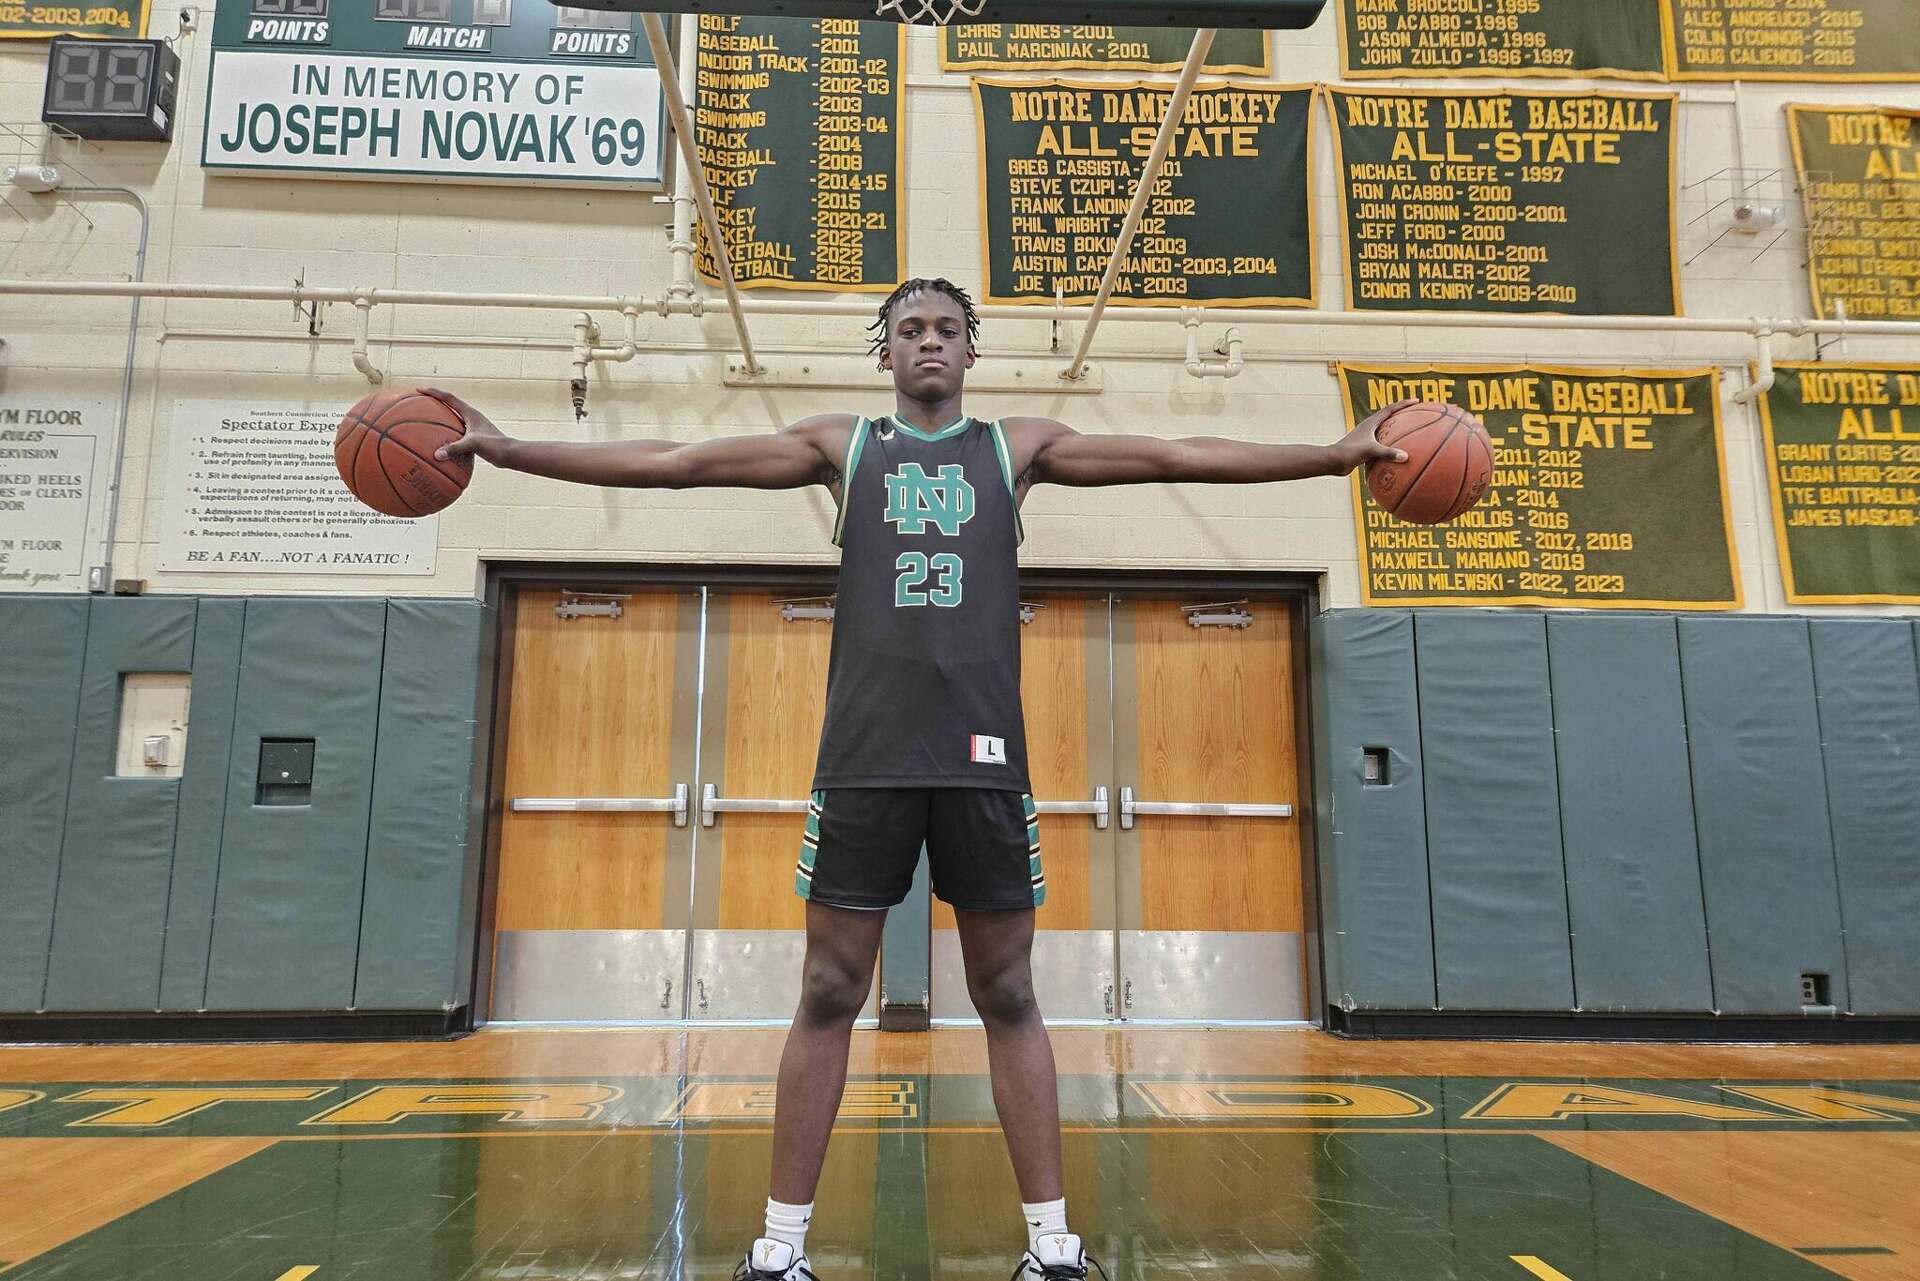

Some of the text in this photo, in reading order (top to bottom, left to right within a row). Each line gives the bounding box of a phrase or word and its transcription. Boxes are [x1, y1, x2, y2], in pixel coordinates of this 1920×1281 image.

[1356, 0, 1398, 13] MARK
[248, 20, 329, 41] POINTS
[700, 14, 741, 32] GOLF
[956, 24, 1001, 39] CHRIS
[1356, 15, 1388, 31] BOB
[407, 26, 486, 49] MATCH
[552, 32, 631, 53] POINTS
[699, 32, 779, 51] BASEBALL
[1359, 31, 1411, 48] JASON
[958, 42, 999, 58] PAUL
[1361, 48, 1402, 65] JOHN
[699, 52, 752, 71] INDOOR
[757, 54, 808, 73] TRACK
[292, 64, 584, 105] IN MEMORY OF
[698, 71, 769, 89] SWIMMING
[698, 89, 750, 110] TRACK
[1010, 91, 1092, 122] NOTRE
[1184, 94, 1281, 125] HOCKEY
[697, 108, 766, 128] SWIMMING
[1346, 96, 1660, 132] NOTRE DAME BASEBALL
[221, 103, 401, 158] JOSEPH
[697, 126, 748, 149] TRACK
[1827, 114, 1911, 147] NOTRE
[697, 145, 776, 167] BASEBALL
[1009, 159, 1048, 176] GREG
[1350, 161, 1565, 183] MICHAEL O'KEEFE 1997
[1010, 178, 1062, 195] STEVE
[1352, 183, 1384, 200] RON
[1011, 198, 1064, 214] FRANK
[1355, 204, 1396, 220] JOHN
[1012, 217, 1047, 233] PHIL
[1357, 223, 1396, 240] JEFF
[1012, 236, 1066, 253] TRAVIS
[1358, 243, 1399, 260] JOSH
[1012, 256, 1067, 273] AUSTIN
[1359, 263, 1410, 280] BRYAN
[1013, 276, 1044, 292] JOE
[1360, 282, 1411, 299] CONOR
[1368, 378, 1694, 415] NOTRE DAME BASEBALL
[1800, 372, 1889, 405] NOTRE
[26, 409, 82, 426] FLOOR
[221, 418, 294, 432] Spectator
[211, 436, 292, 446] Respect decisions
[1777, 444, 1831, 461] GRANT
[38, 474, 82, 486] HEELS
[1781, 465, 1835, 482] LOGAN
[36, 488, 82, 499] CLEATS
[1783, 487, 1816, 504] TYE
[1788, 508, 1842, 526] JAMES
[202, 529, 240, 538] Respect
[1370, 531, 1440, 549] MICHAEL
[1446, 530, 1522, 549] SANSONE
[1586, 533, 1633, 551] 2018
[22, 539, 63, 551] FLOOR
[187, 551, 209, 562] BE
[213, 551, 224, 562] A
[316, 553, 328, 563] A
[333, 552, 400, 565] FANATIC
[1372, 551, 1450, 569] MAXWELL
[895, 551, 963, 607] 23
[1373, 573, 1423, 591] KEVIN
[1428, 573, 1504, 591] MILEWSKI
[1575, 575, 1625, 593] 2023
[988, 740, 996, 755] L
